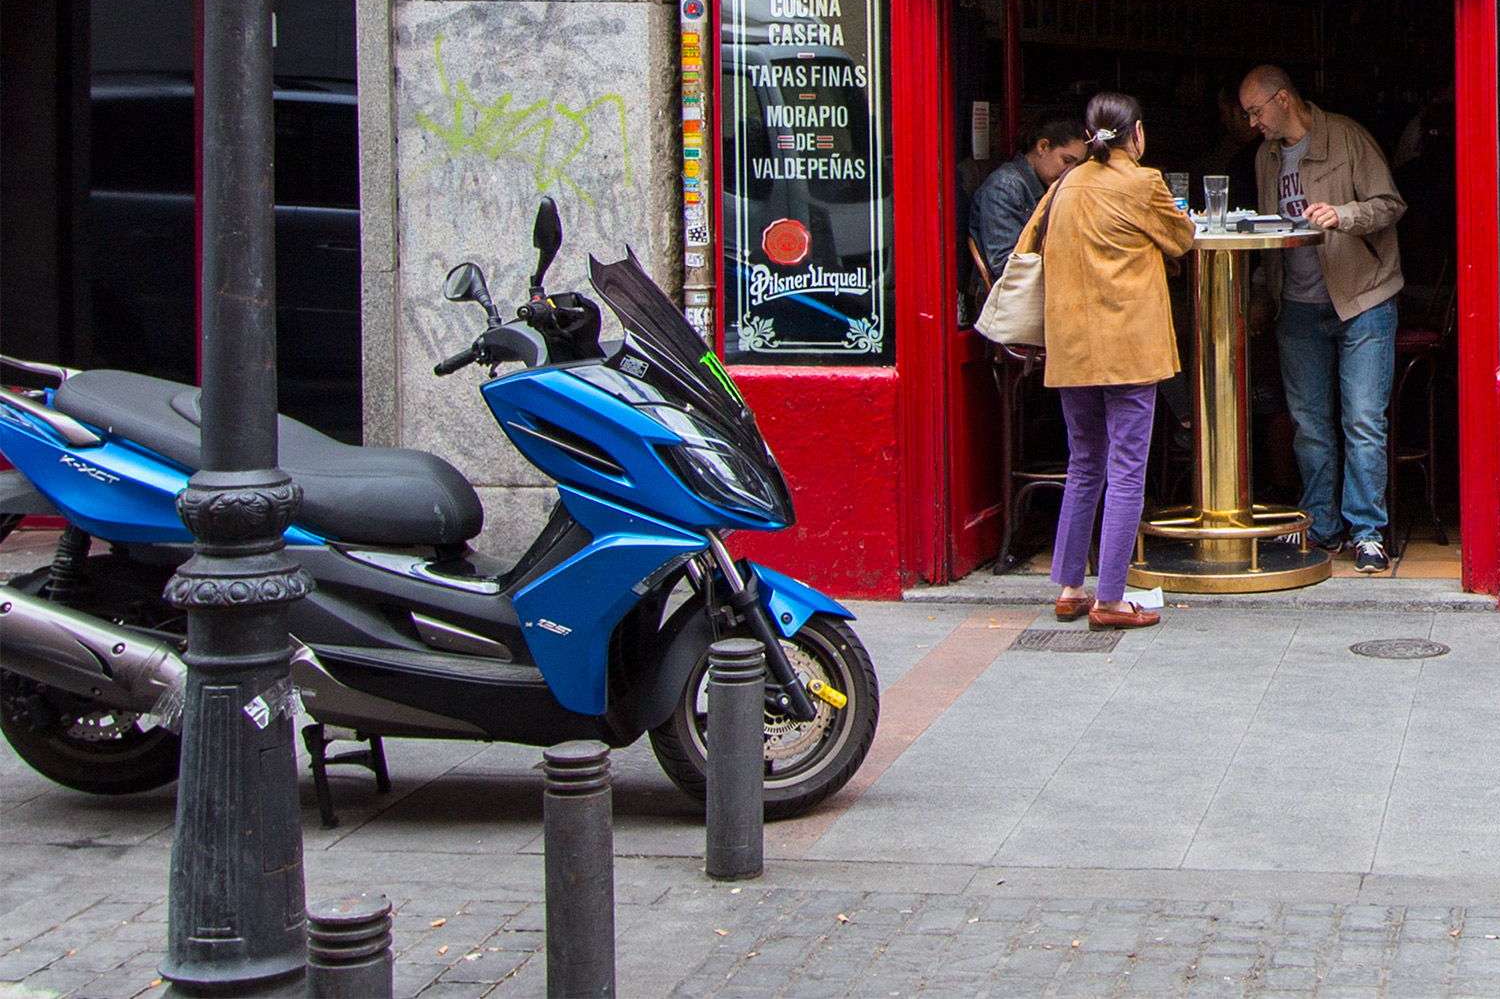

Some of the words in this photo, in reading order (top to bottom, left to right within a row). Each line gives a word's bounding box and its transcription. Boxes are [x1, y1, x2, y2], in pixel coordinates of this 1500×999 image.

[768, 23, 844, 46] CASERA
[748, 64, 807, 88] TAPAS
[811, 64, 867, 88] FINAS
[766, 105, 848, 128] MORAPIO
[796, 133, 815, 151] DE
[752, 153, 866, 179] VALDEPEÑAS
[750, 264, 811, 306] Pilsner
[808, 264, 868, 296] Urquell
